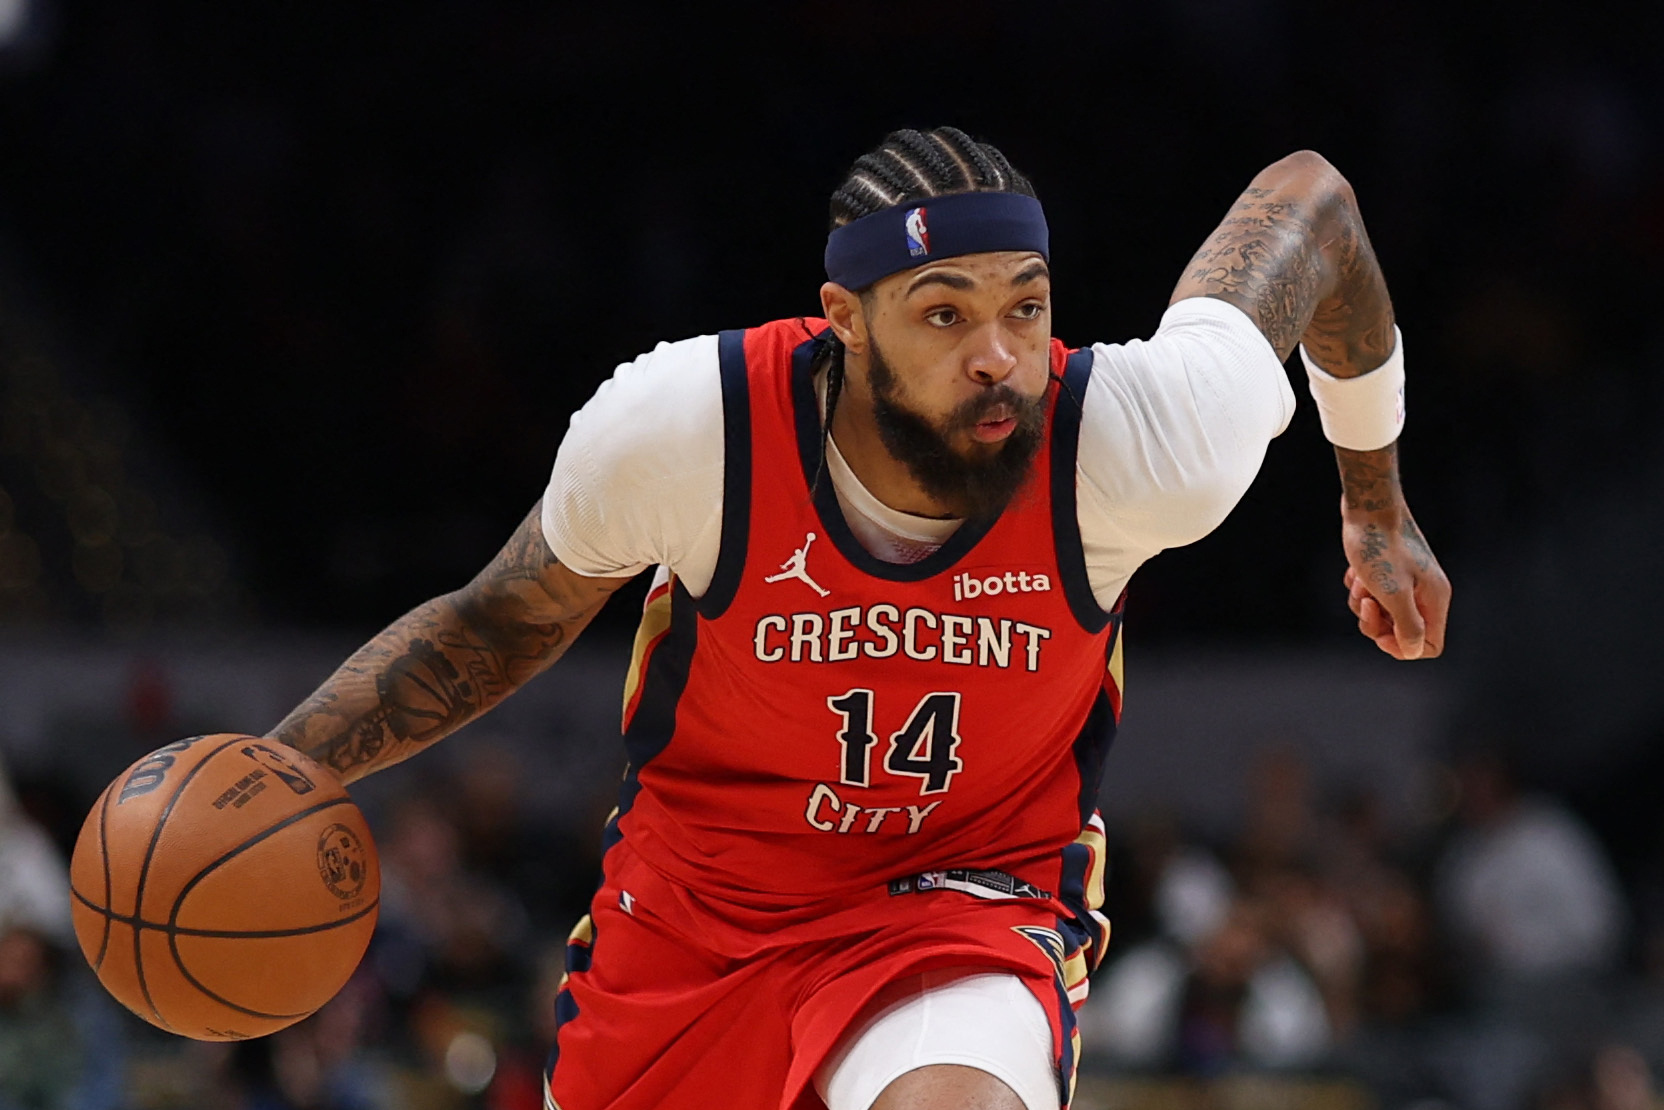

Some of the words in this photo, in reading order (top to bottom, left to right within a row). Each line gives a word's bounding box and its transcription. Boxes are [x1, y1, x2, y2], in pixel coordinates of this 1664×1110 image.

[953, 571, 1051, 602] ibotta
[753, 603, 1052, 672] CRESCENT
[826, 687, 963, 797] 14
[805, 782, 944, 835] CITY
